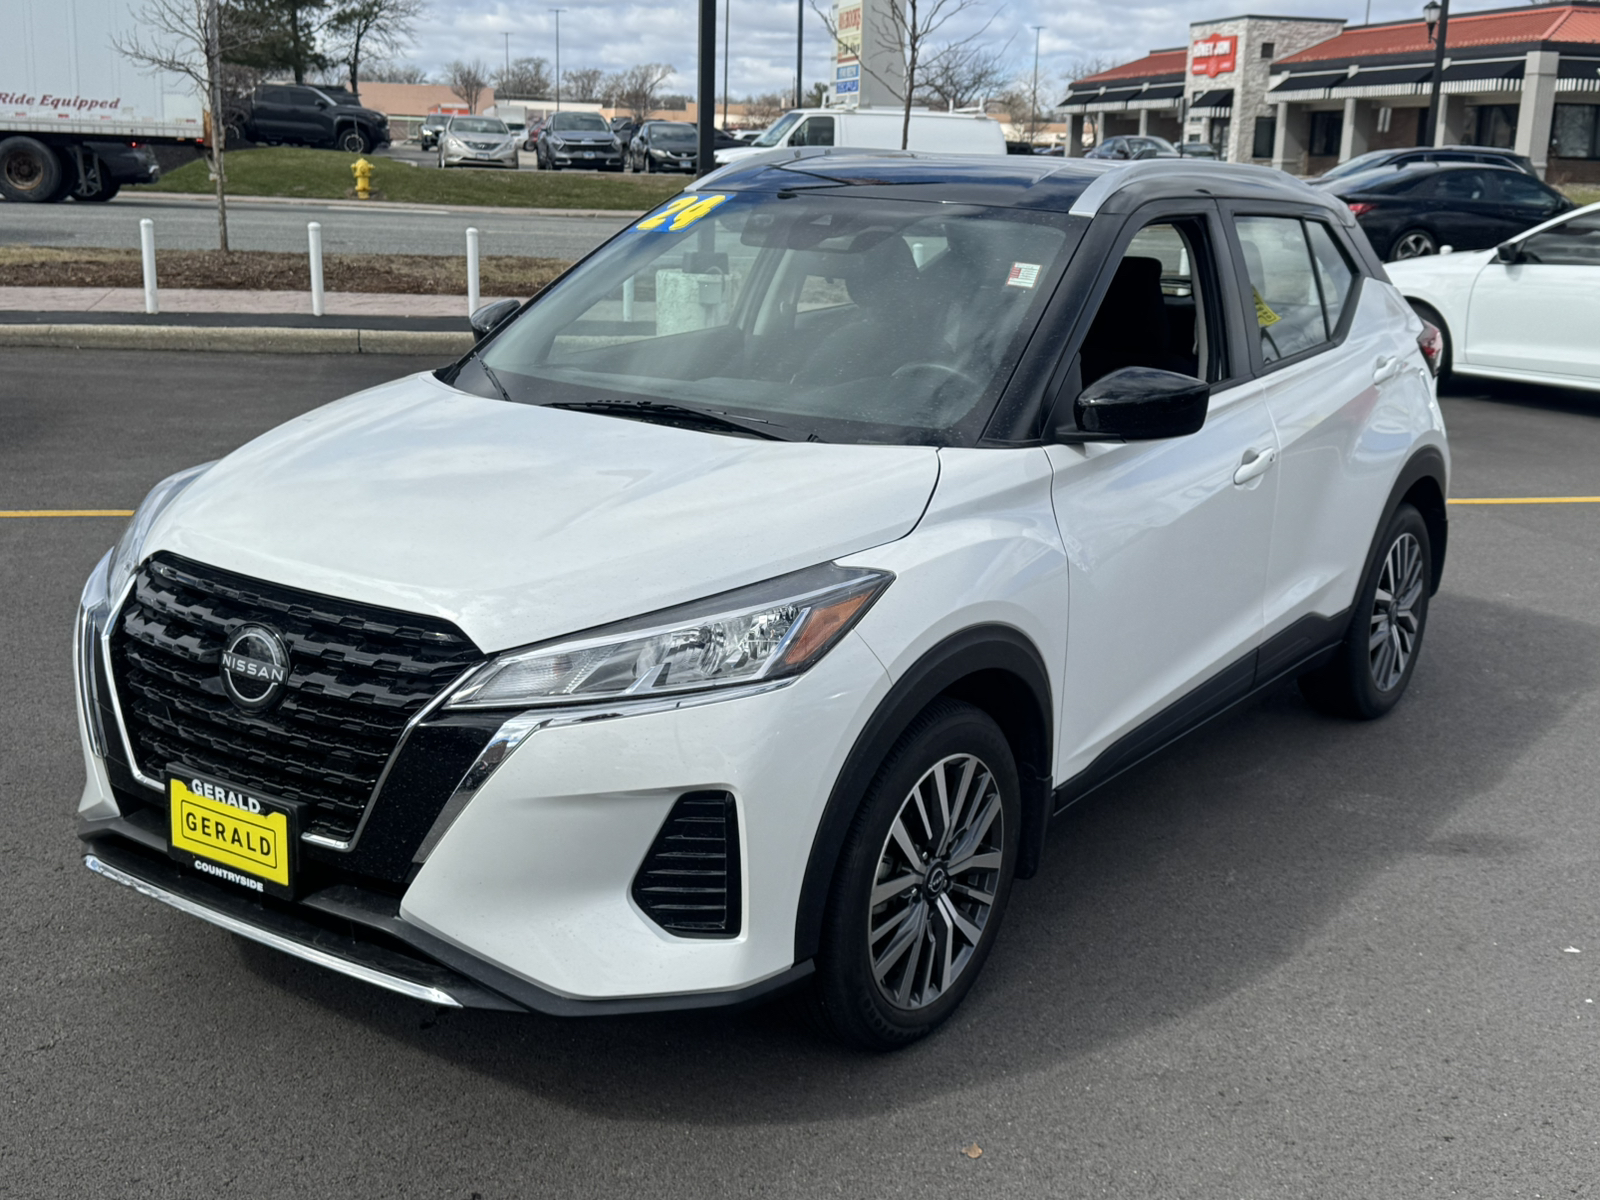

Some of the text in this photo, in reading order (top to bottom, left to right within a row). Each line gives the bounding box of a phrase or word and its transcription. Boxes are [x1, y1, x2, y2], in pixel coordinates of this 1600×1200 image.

[0, 92, 121, 111] Ride Equipped
[636, 194, 726, 231] 24
[222, 653, 284, 682] NISSAN
[191, 778, 261, 814] GERALD
[185, 812, 271, 856] GERALD
[194, 860, 264, 892] COUNTRYSIDE
